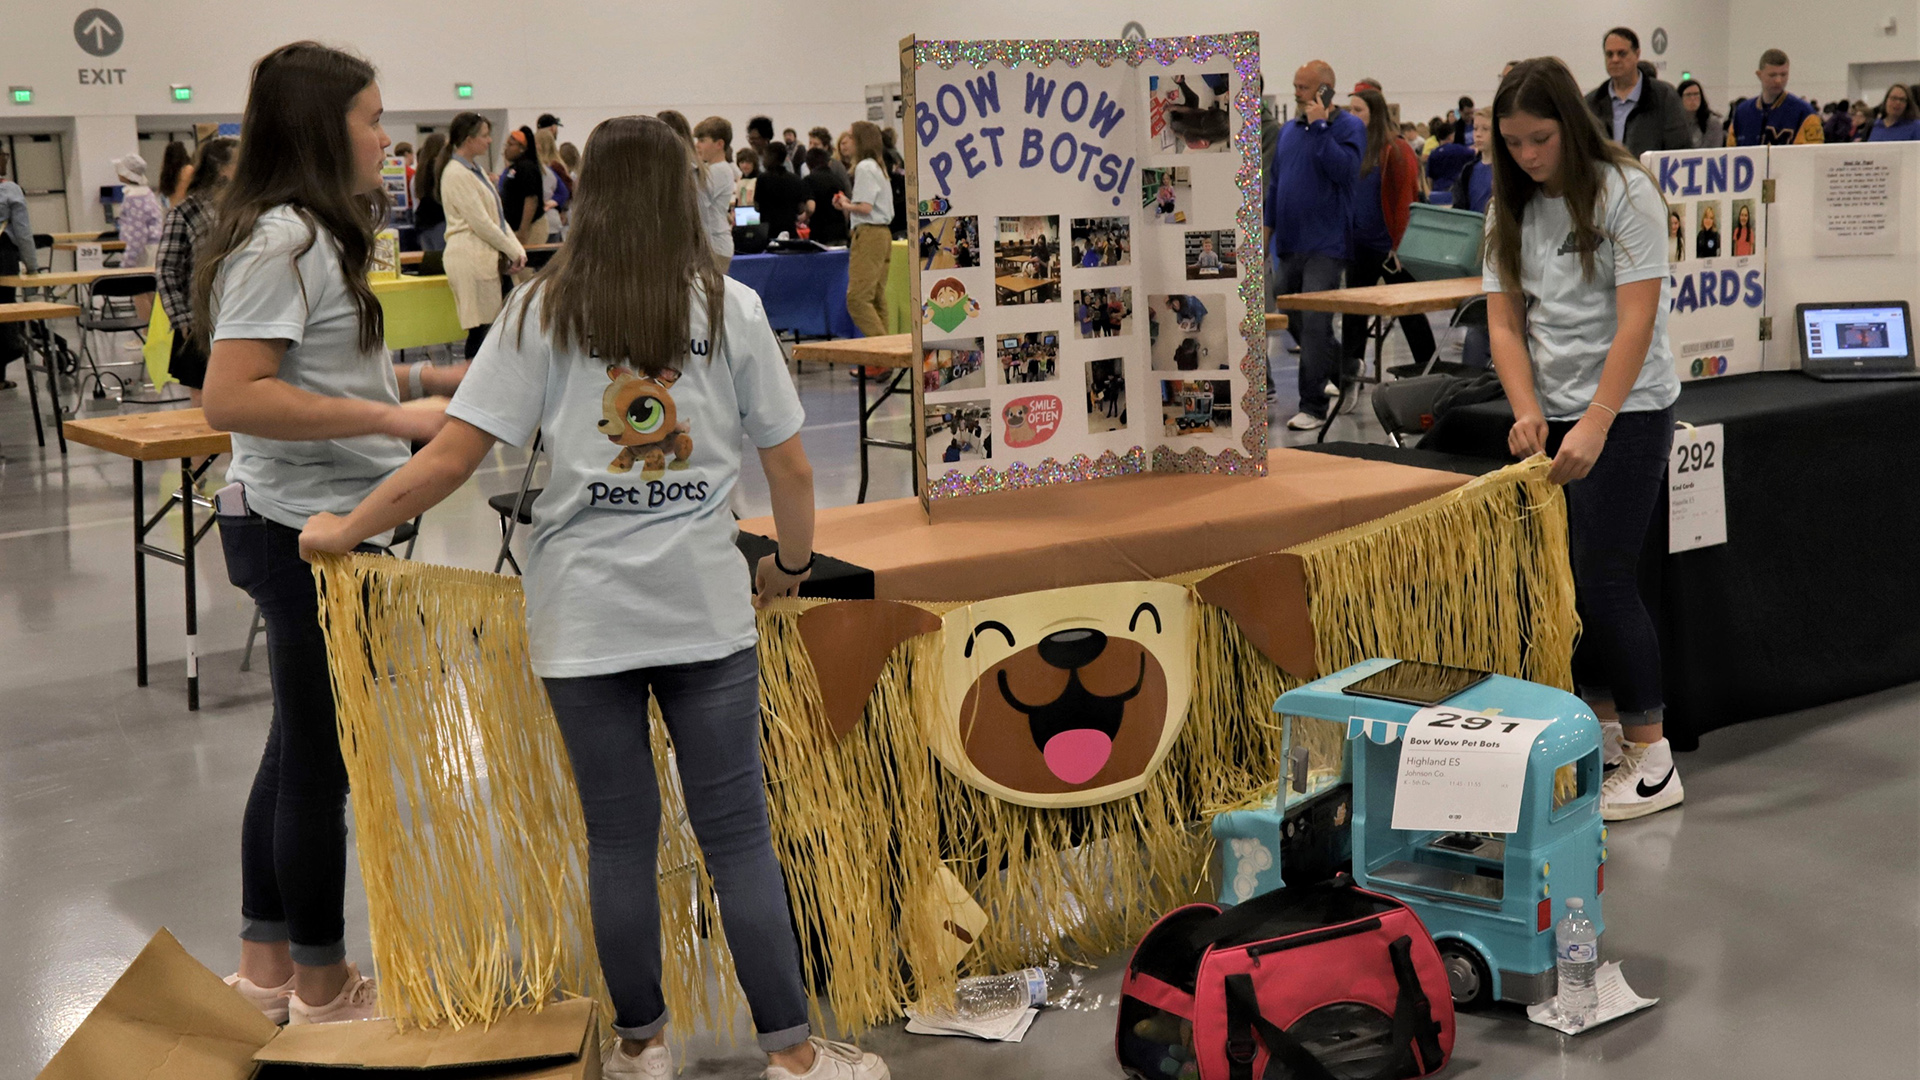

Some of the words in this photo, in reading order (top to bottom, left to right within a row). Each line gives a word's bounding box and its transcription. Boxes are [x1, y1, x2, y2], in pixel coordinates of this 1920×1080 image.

[78, 68, 126, 84] EXIT
[916, 70, 1000, 147] BOW
[1025, 72, 1125, 138] WOW
[930, 127, 1005, 196] PET
[1019, 128, 1135, 206] BOTS!
[1659, 154, 1754, 196] KIND
[80, 248, 98, 256] 397
[1029, 399, 1056, 412] SMILE
[1028, 410, 1059, 424] OFTEN
[1677, 441, 1715, 474] 292
[587, 482, 640, 506] Pet
[1428, 712, 1520, 734] 291
[1410, 737, 1431, 746] Bow
[1434, 738, 1459, 747] Wow
[1480, 740, 1500, 749] Bots
[1406, 757, 1446, 768] Highland
[1449, 758, 1461, 767] ES
[1405, 770, 1432, 778] Johnson
